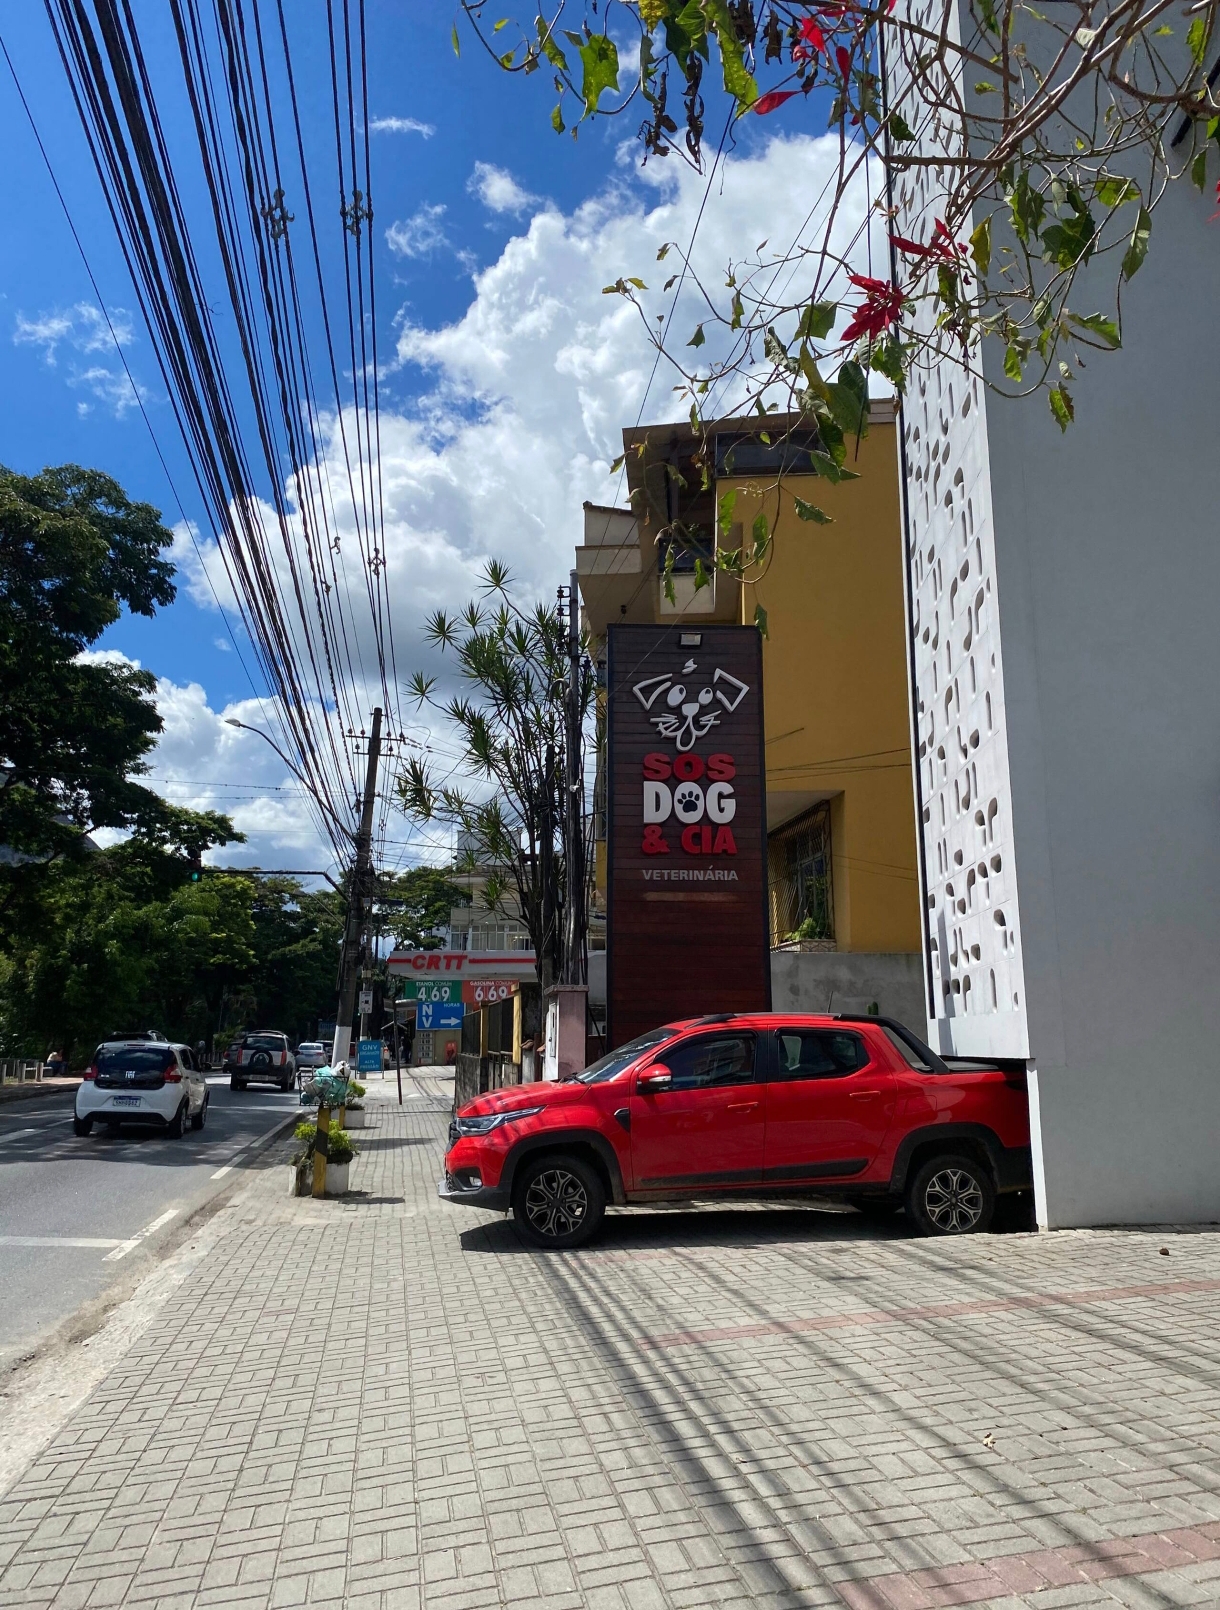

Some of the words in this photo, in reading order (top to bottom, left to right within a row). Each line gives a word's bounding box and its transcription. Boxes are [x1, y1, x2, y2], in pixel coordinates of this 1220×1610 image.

[642, 752, 736, 782] SOS
[643, 780, 736, 824] DOG
[641, 825, 671, 855] &
[681, 825, 738, 855] CIA
[642, 865, 739, 881] VETERINÁRIA
[411, 954, 468, 971] CRTT
[417, 987, 450, 1002] 4.69
[475, 986, 508, 1001] 6.69
